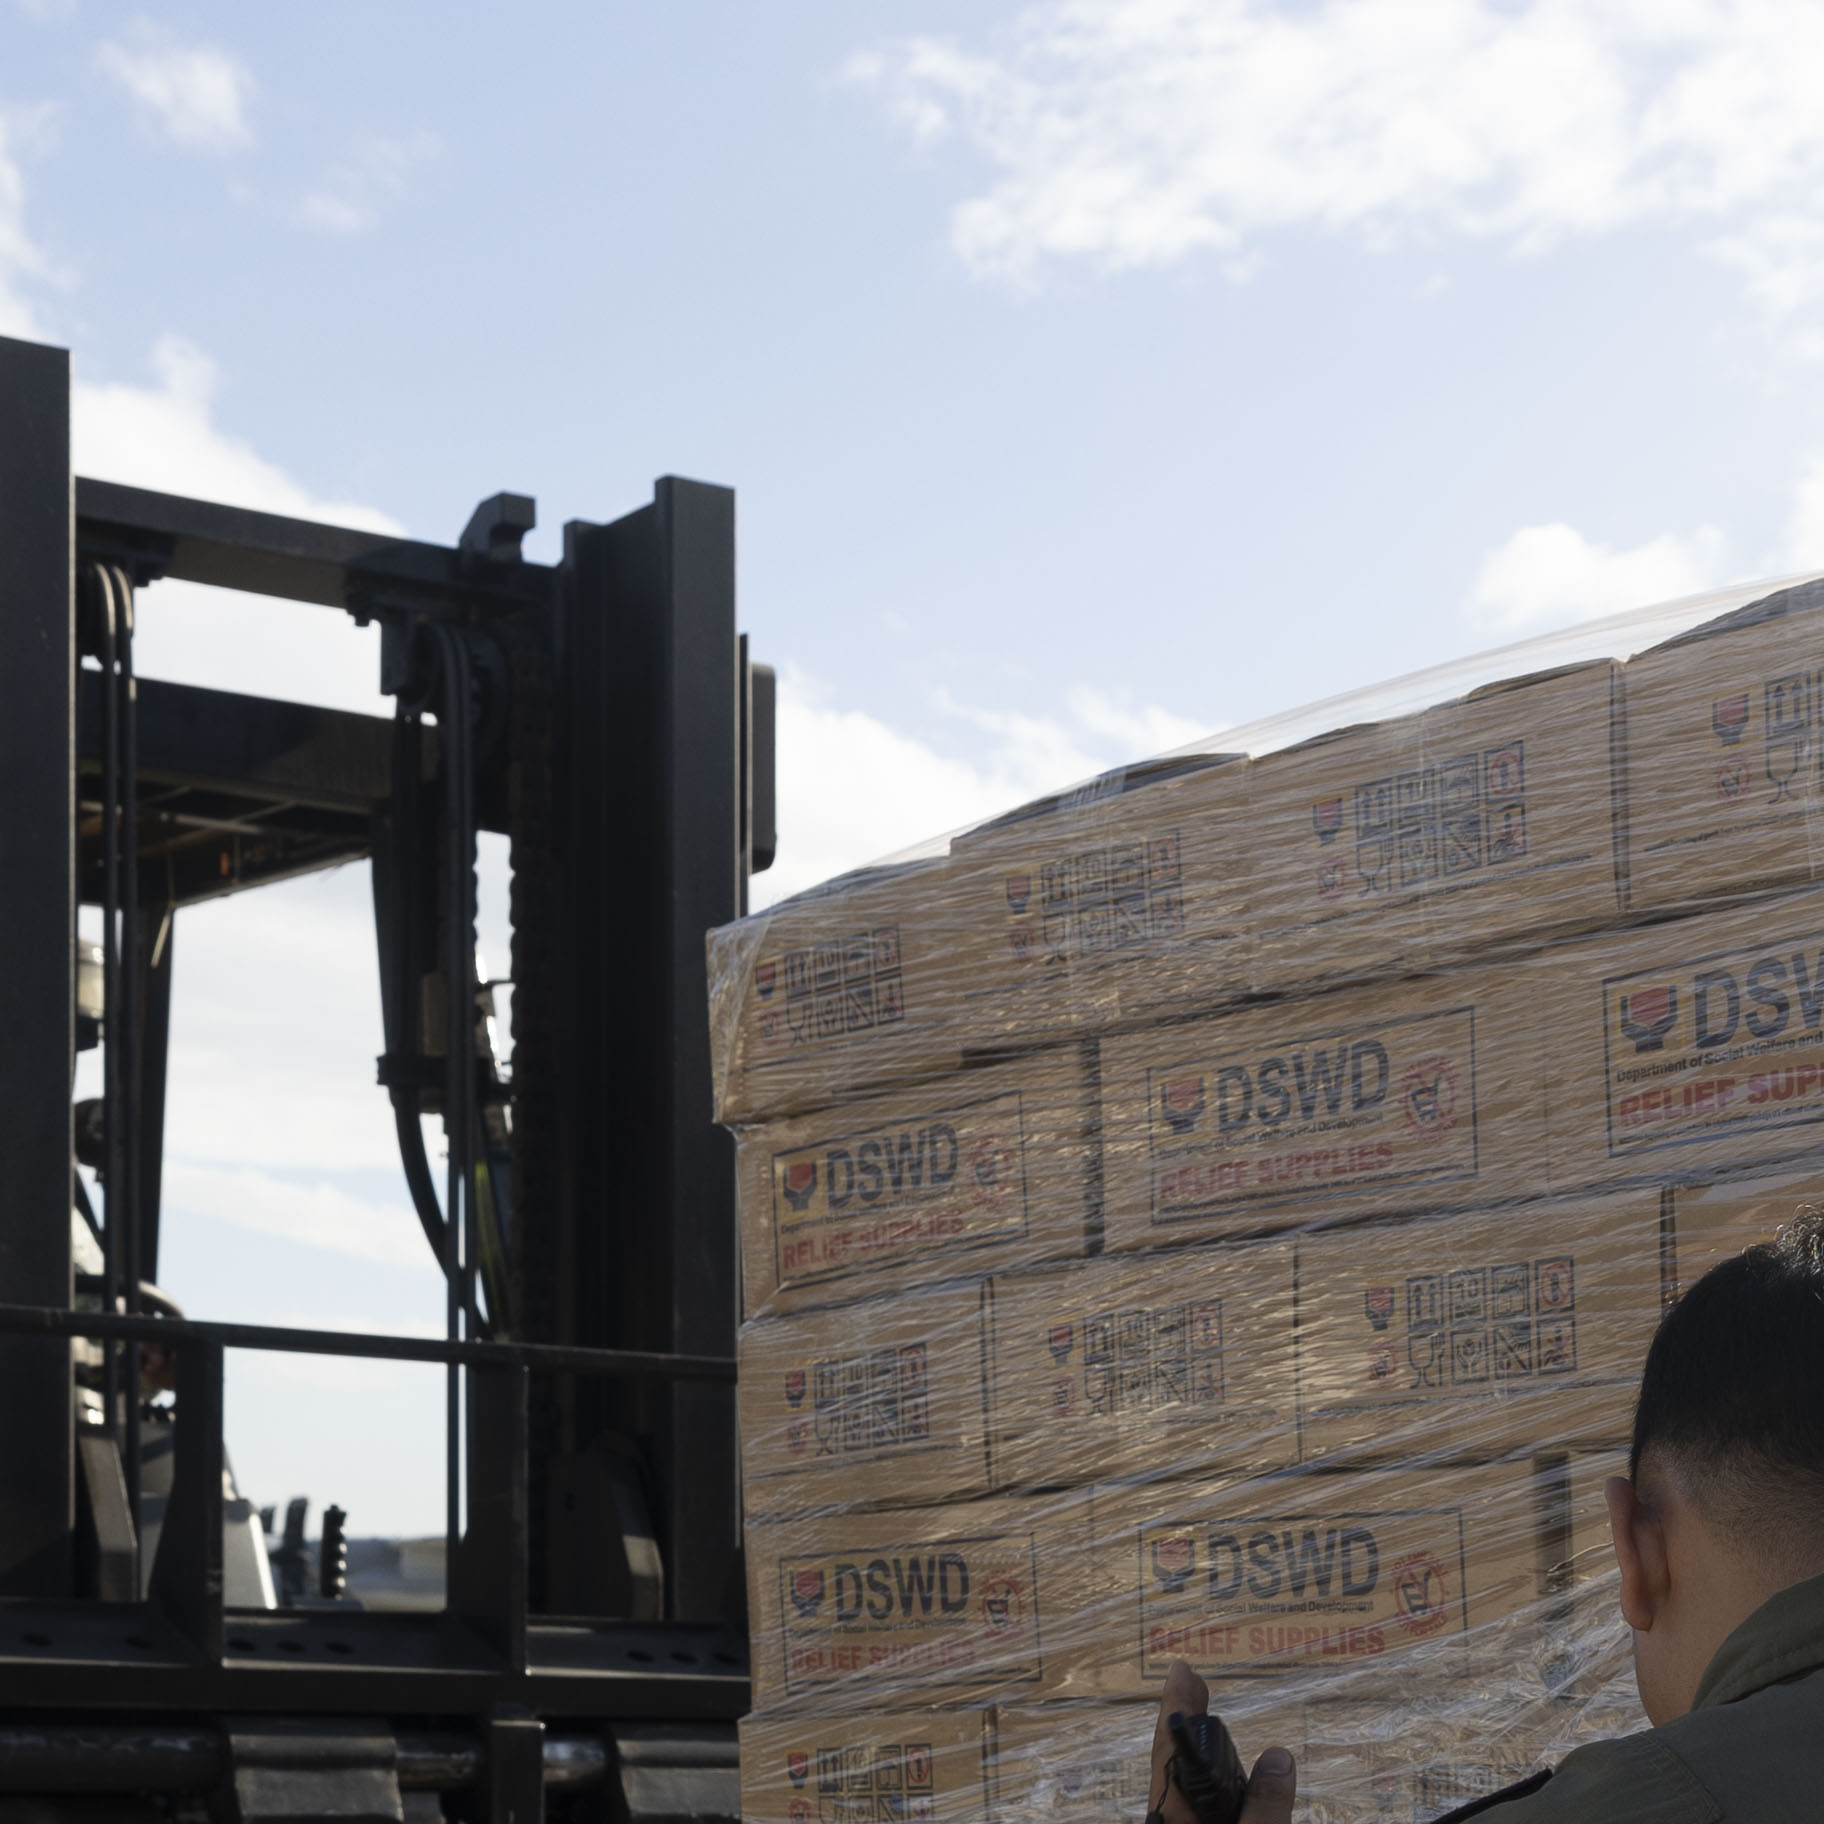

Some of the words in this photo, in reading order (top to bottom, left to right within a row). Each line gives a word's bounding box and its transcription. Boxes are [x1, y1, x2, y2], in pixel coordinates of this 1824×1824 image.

[1217, 1042, 1388, 1134] DSWD
[1616, 1075, 1735, 1127] RELIEF
[827, 1124, 958, 1209] DSWD
[834, 1554, 969, 1622] DSWD
[1207, 1529, 1377, 1598] DSWD
[789, 1645, 862, 1674] RELIEF
[1246, 1622, 1384, 1654] SUPPLIES
